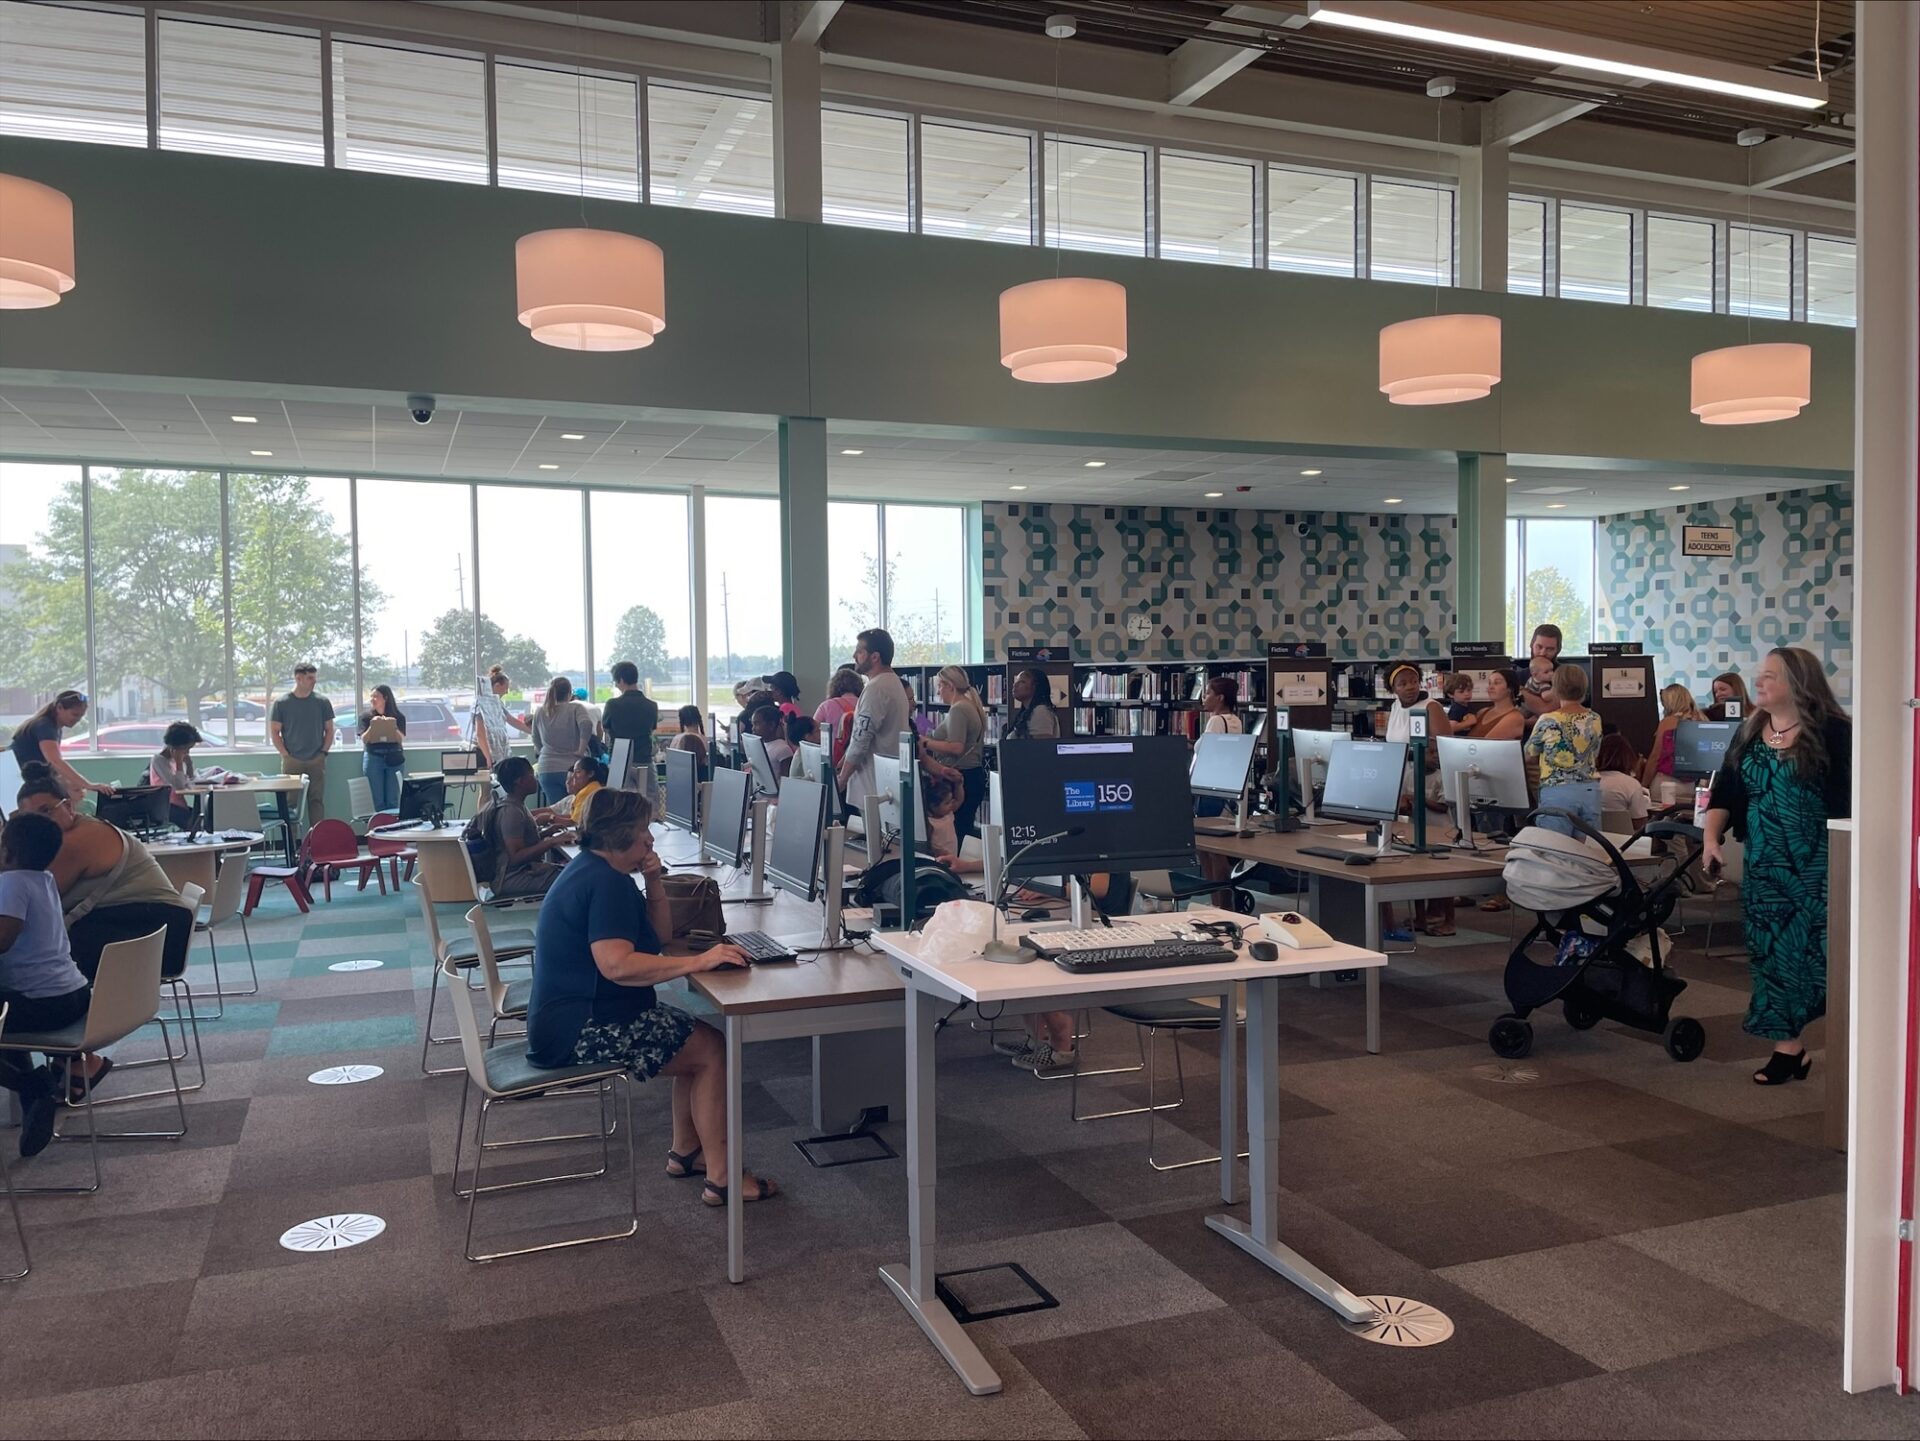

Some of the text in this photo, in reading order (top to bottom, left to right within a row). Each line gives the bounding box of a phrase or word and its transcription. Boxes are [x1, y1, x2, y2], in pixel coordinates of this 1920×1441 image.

[1688, 543, 1731, 551] ADOLESCENTES
[1296, 674, 1305, 682] 14
[1478, 671, 1486, 680] 15
[1729, 705, 1736, 715] 3
[1280, 716, 1285, 727] 7
[1414, 721, 1421, 734] 8
[1065, 787, 1080, 795] The
[1098, 784, 1132, 802] 150
[1066, 800, 1095, 808] Library
[1010, 825, 1036, 838] 12:15
